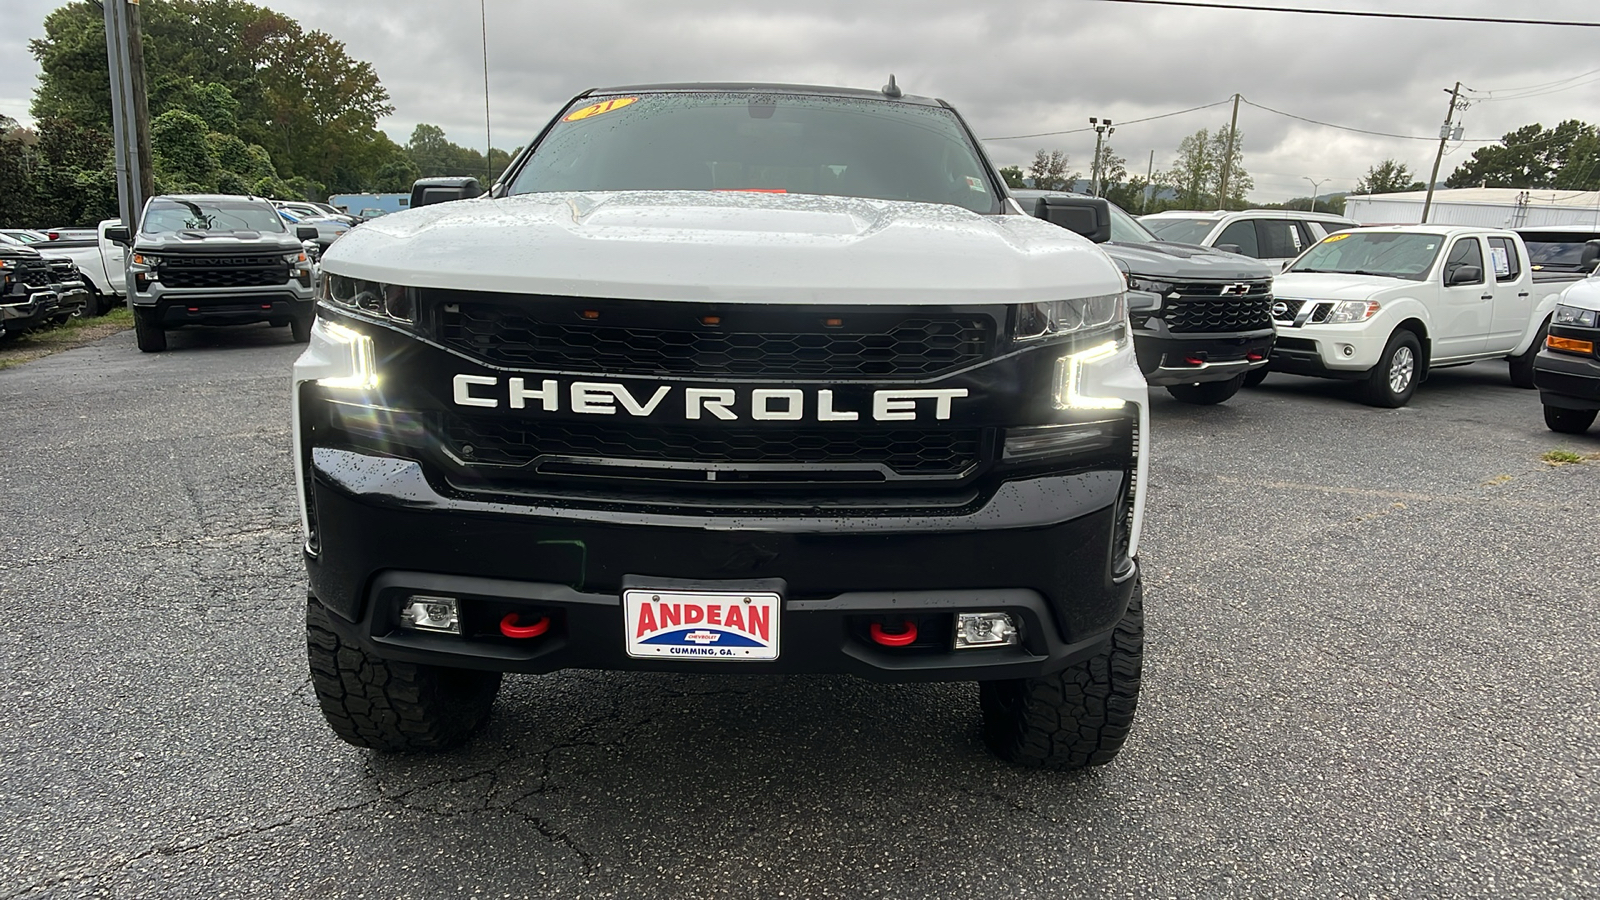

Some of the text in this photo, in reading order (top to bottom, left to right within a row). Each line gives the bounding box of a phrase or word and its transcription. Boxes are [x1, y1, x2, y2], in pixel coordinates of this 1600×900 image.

[586, 101, 614, 117] 21
[453, 374, 969, 421] CHEVROLET
[636, 602, 770, 642] ANDEAN
[670, 647, 717, 656] CUMMING,
